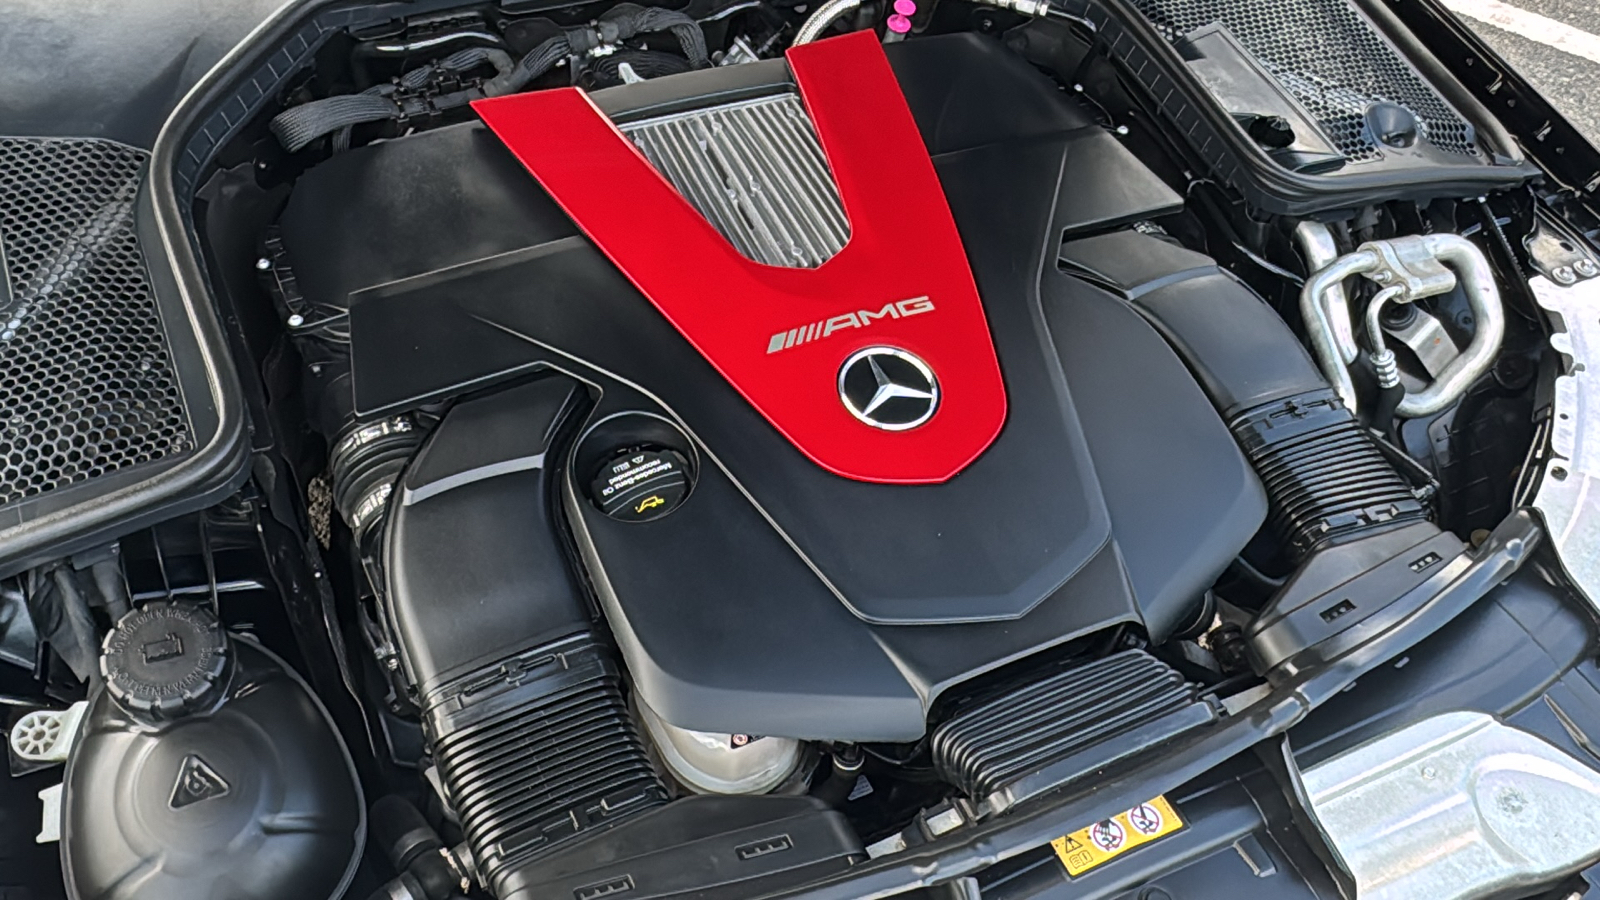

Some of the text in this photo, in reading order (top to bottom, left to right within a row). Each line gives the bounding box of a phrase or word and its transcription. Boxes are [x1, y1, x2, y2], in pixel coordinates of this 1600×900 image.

[823, 295, 935, 337] AMG
[609, 459, 661, 485] recommended
[614, 462, 672, 489] Mercedes-Benz
